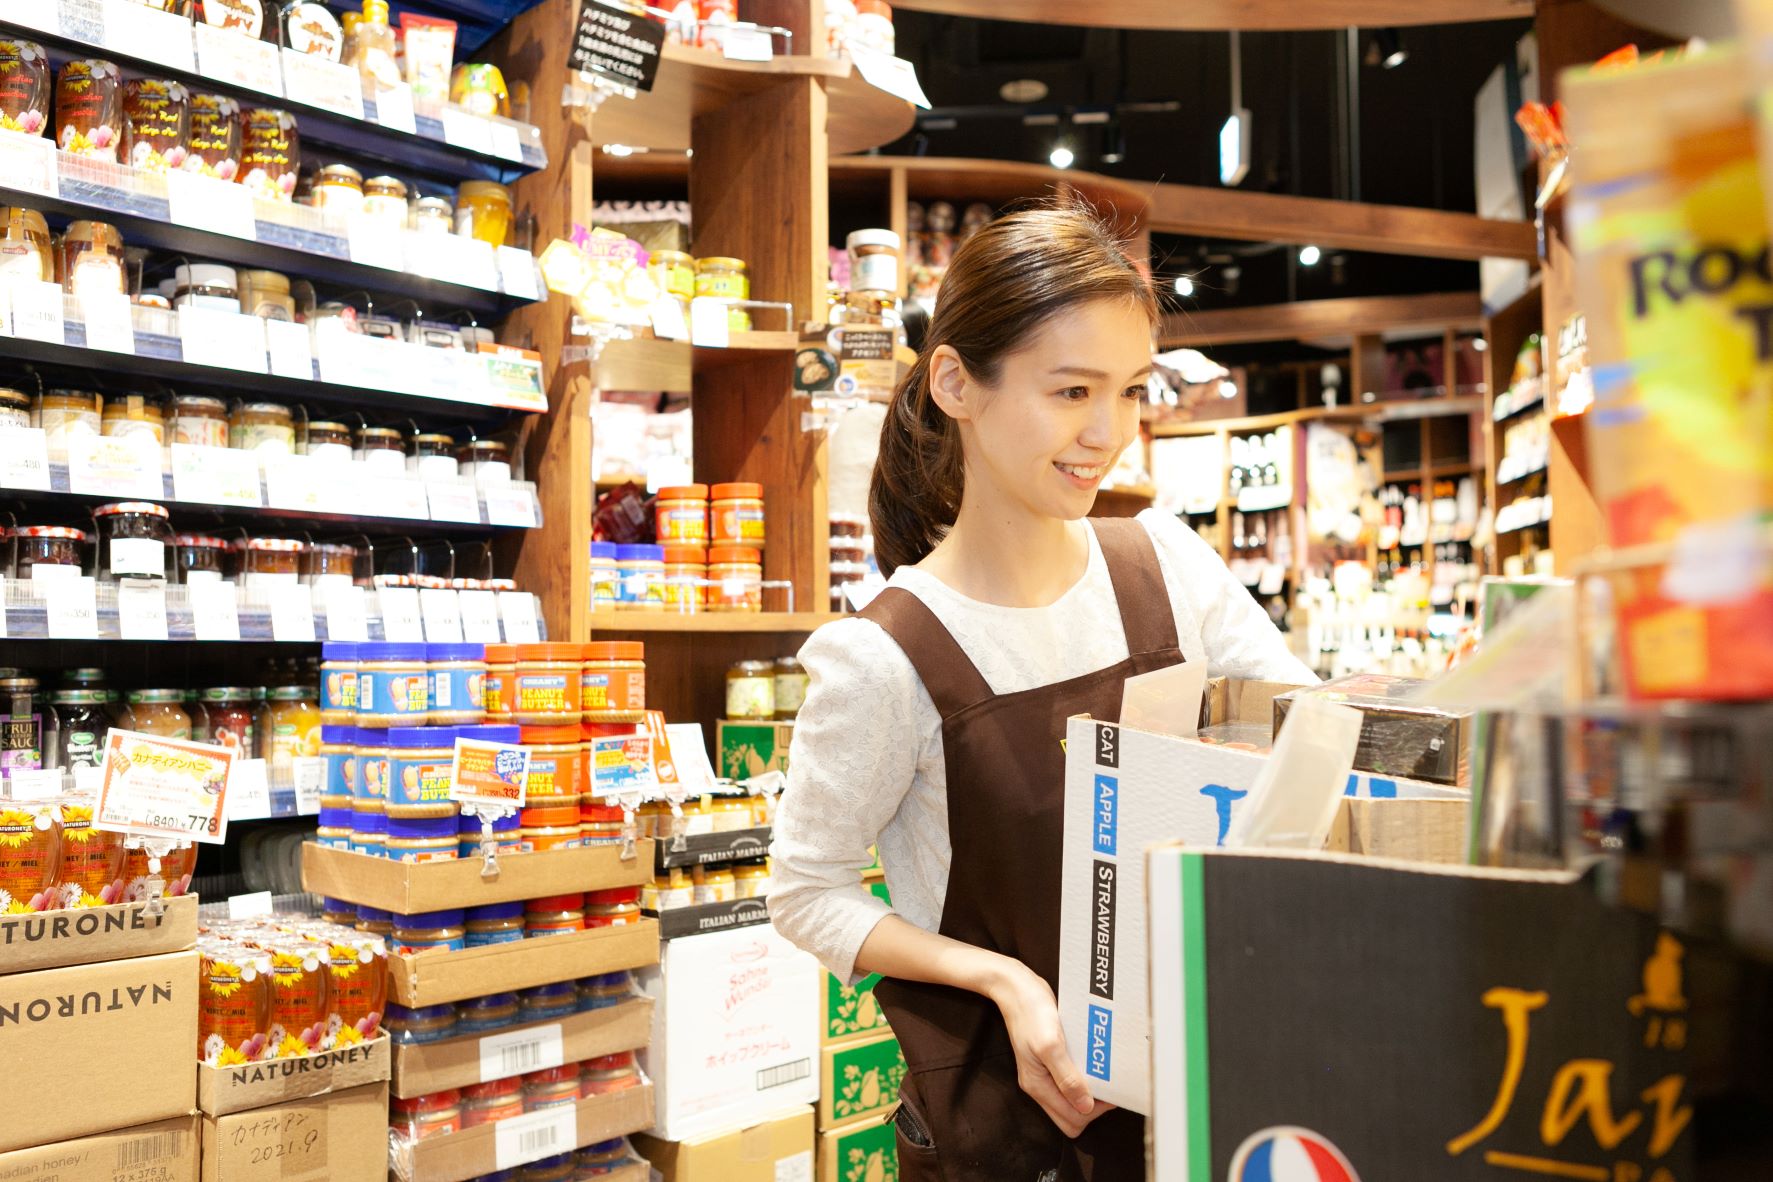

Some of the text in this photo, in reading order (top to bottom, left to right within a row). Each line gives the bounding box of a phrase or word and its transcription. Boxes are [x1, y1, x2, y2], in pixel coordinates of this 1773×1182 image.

[521, 688, 565, 699] PEANUT
[521, 699, 565, 710] BUTTER
[131, 752, 213, 772] カナディアンハニー
[1098, 782, 1115, 847] APPLE
[699, 850, 734, 863] ITALIAN
[699, 913, 737, 929] ITALIAN
[1095, 866, 1114, 995] STRAWBERRY
[1092, 1010, 1109, 1075] PEACH
[704, 1039, 792, 1068] ホイップクリーム
[232, 1045, 374, 1087] NATURONEY
[231, 1112, 309, 1147] カナディアン
[42, 1153, 81, 1172] honey
[137, 1168, 157, 1180] 375
[159, 1166, 167, 1176] g
